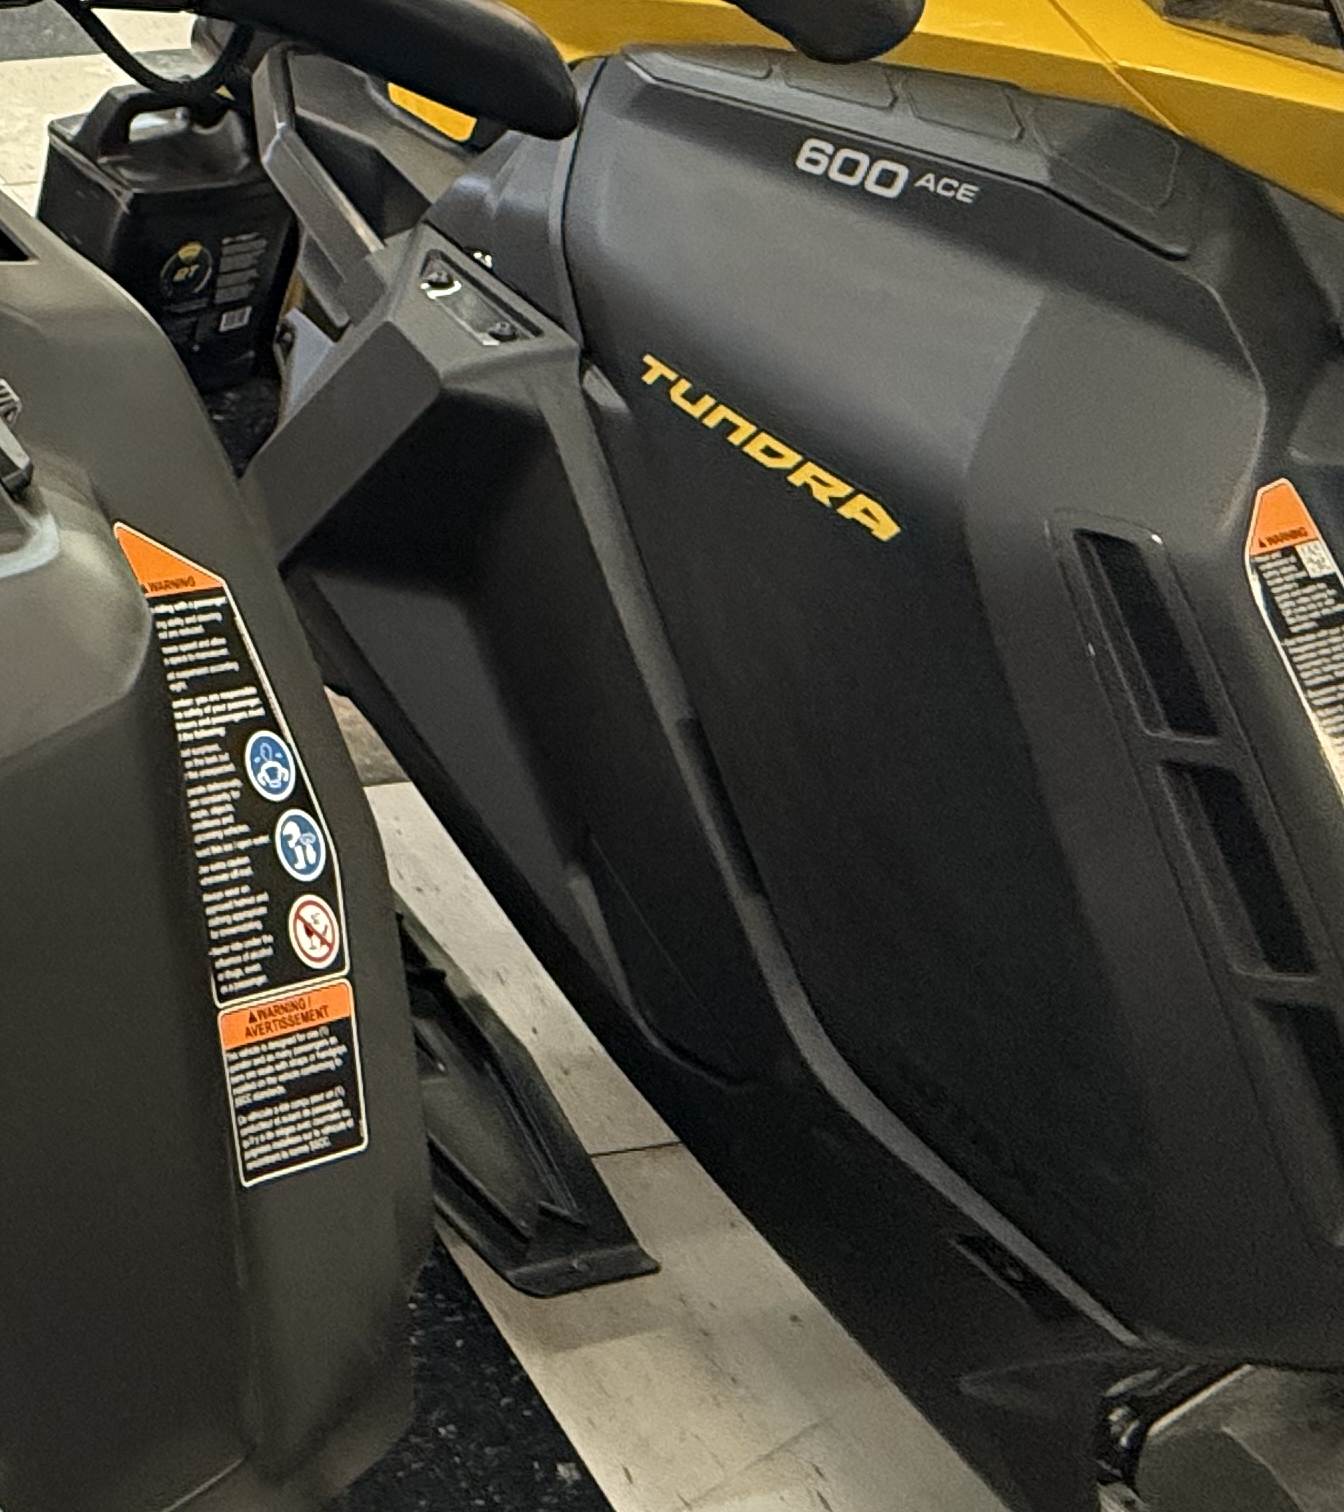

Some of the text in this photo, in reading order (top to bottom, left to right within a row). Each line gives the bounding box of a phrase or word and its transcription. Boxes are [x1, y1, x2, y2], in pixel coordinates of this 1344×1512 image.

[795, 137, 981, 205] 600 ACE
[639, 353, 901, 543] TUNDRA
[1267, 527, 1309, 546] WARNING
[149, 576, 197, 592] WARNING
[245, 1005, 329, 1038] AVERTISSEMENT
[258, 998, 306, 1020] WARNING
